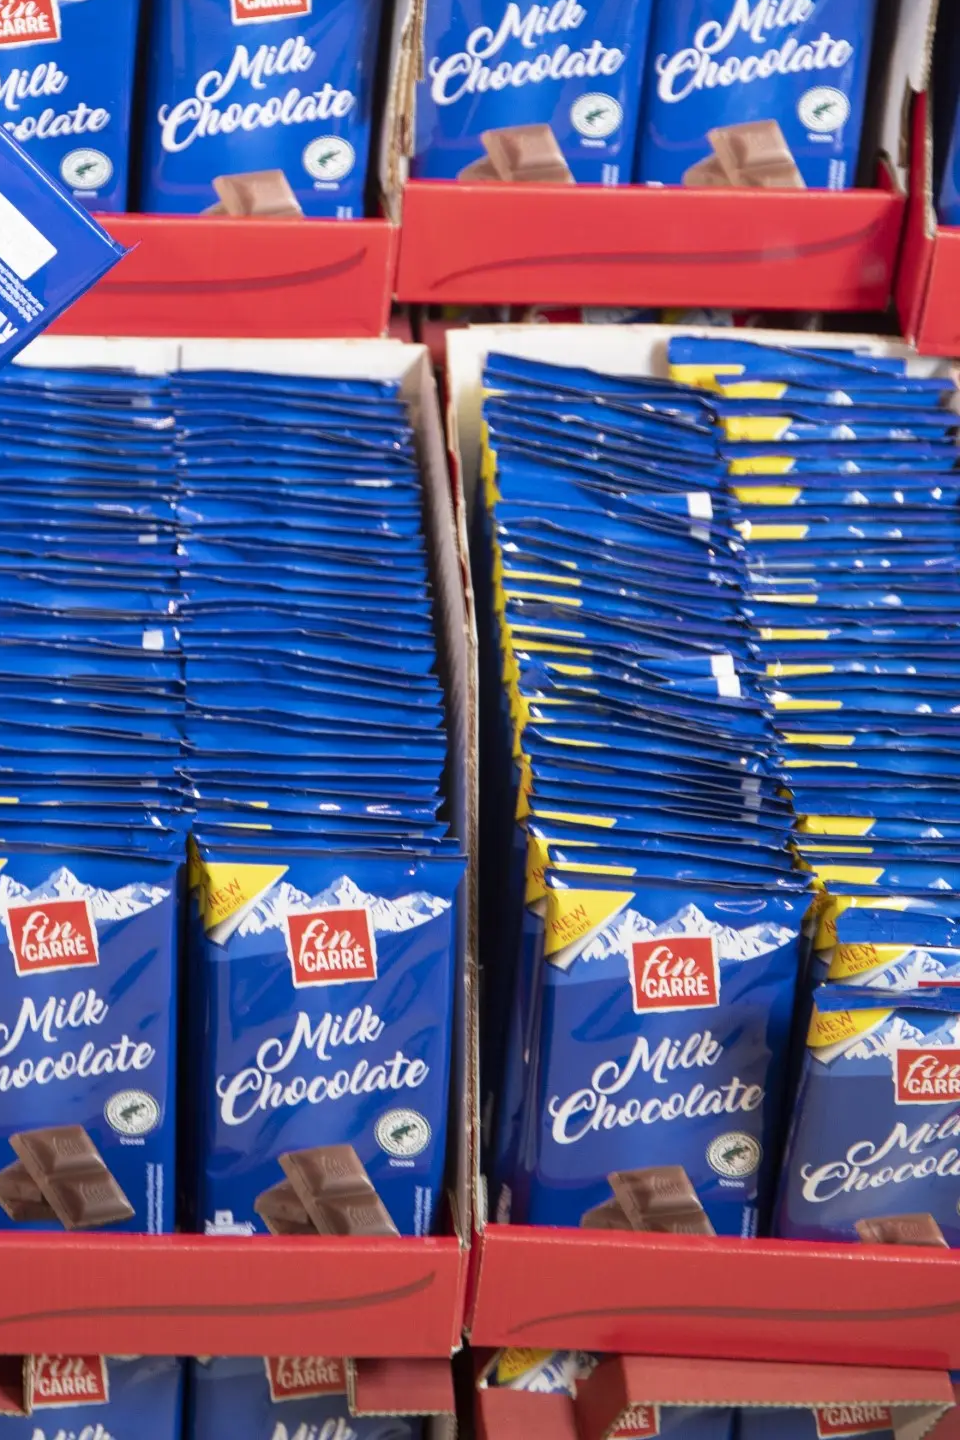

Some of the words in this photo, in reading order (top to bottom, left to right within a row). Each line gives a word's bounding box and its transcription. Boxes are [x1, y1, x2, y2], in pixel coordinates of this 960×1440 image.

[196, 35, 317, 103] Milk
[431, 40, 624, 106] Chocolate
[656, 32, 852, 103] Chocolate
[158, 82, 355, 153] Chocolate
[208, 878, 241, 910] NEW
[21, 911, 76, 959] fin
[300, 919, 355, 966] fin
[552, 904, 587, 935] NEW
[25, 933, 88, 962] CARRÉ
[302, 944, 366, 972] CARRÉ
[839, 944, 876, 963] NEW
[641, 946, 700, 1002] fin
[645, 972, 709, 999] CARRÉ
[257, 1004, 384, 1073] Milk
[816, 1011, 852, 1035] NEW
[592, 1030, 724, 1095] Milk
[907, 1077, 960, 1094] CARR
[216, 1051, 430, 1126] Chocolate
[549, 1077, 765, 1144] Chocolate
[40, 1371, 99, 1396] CARRÉ
